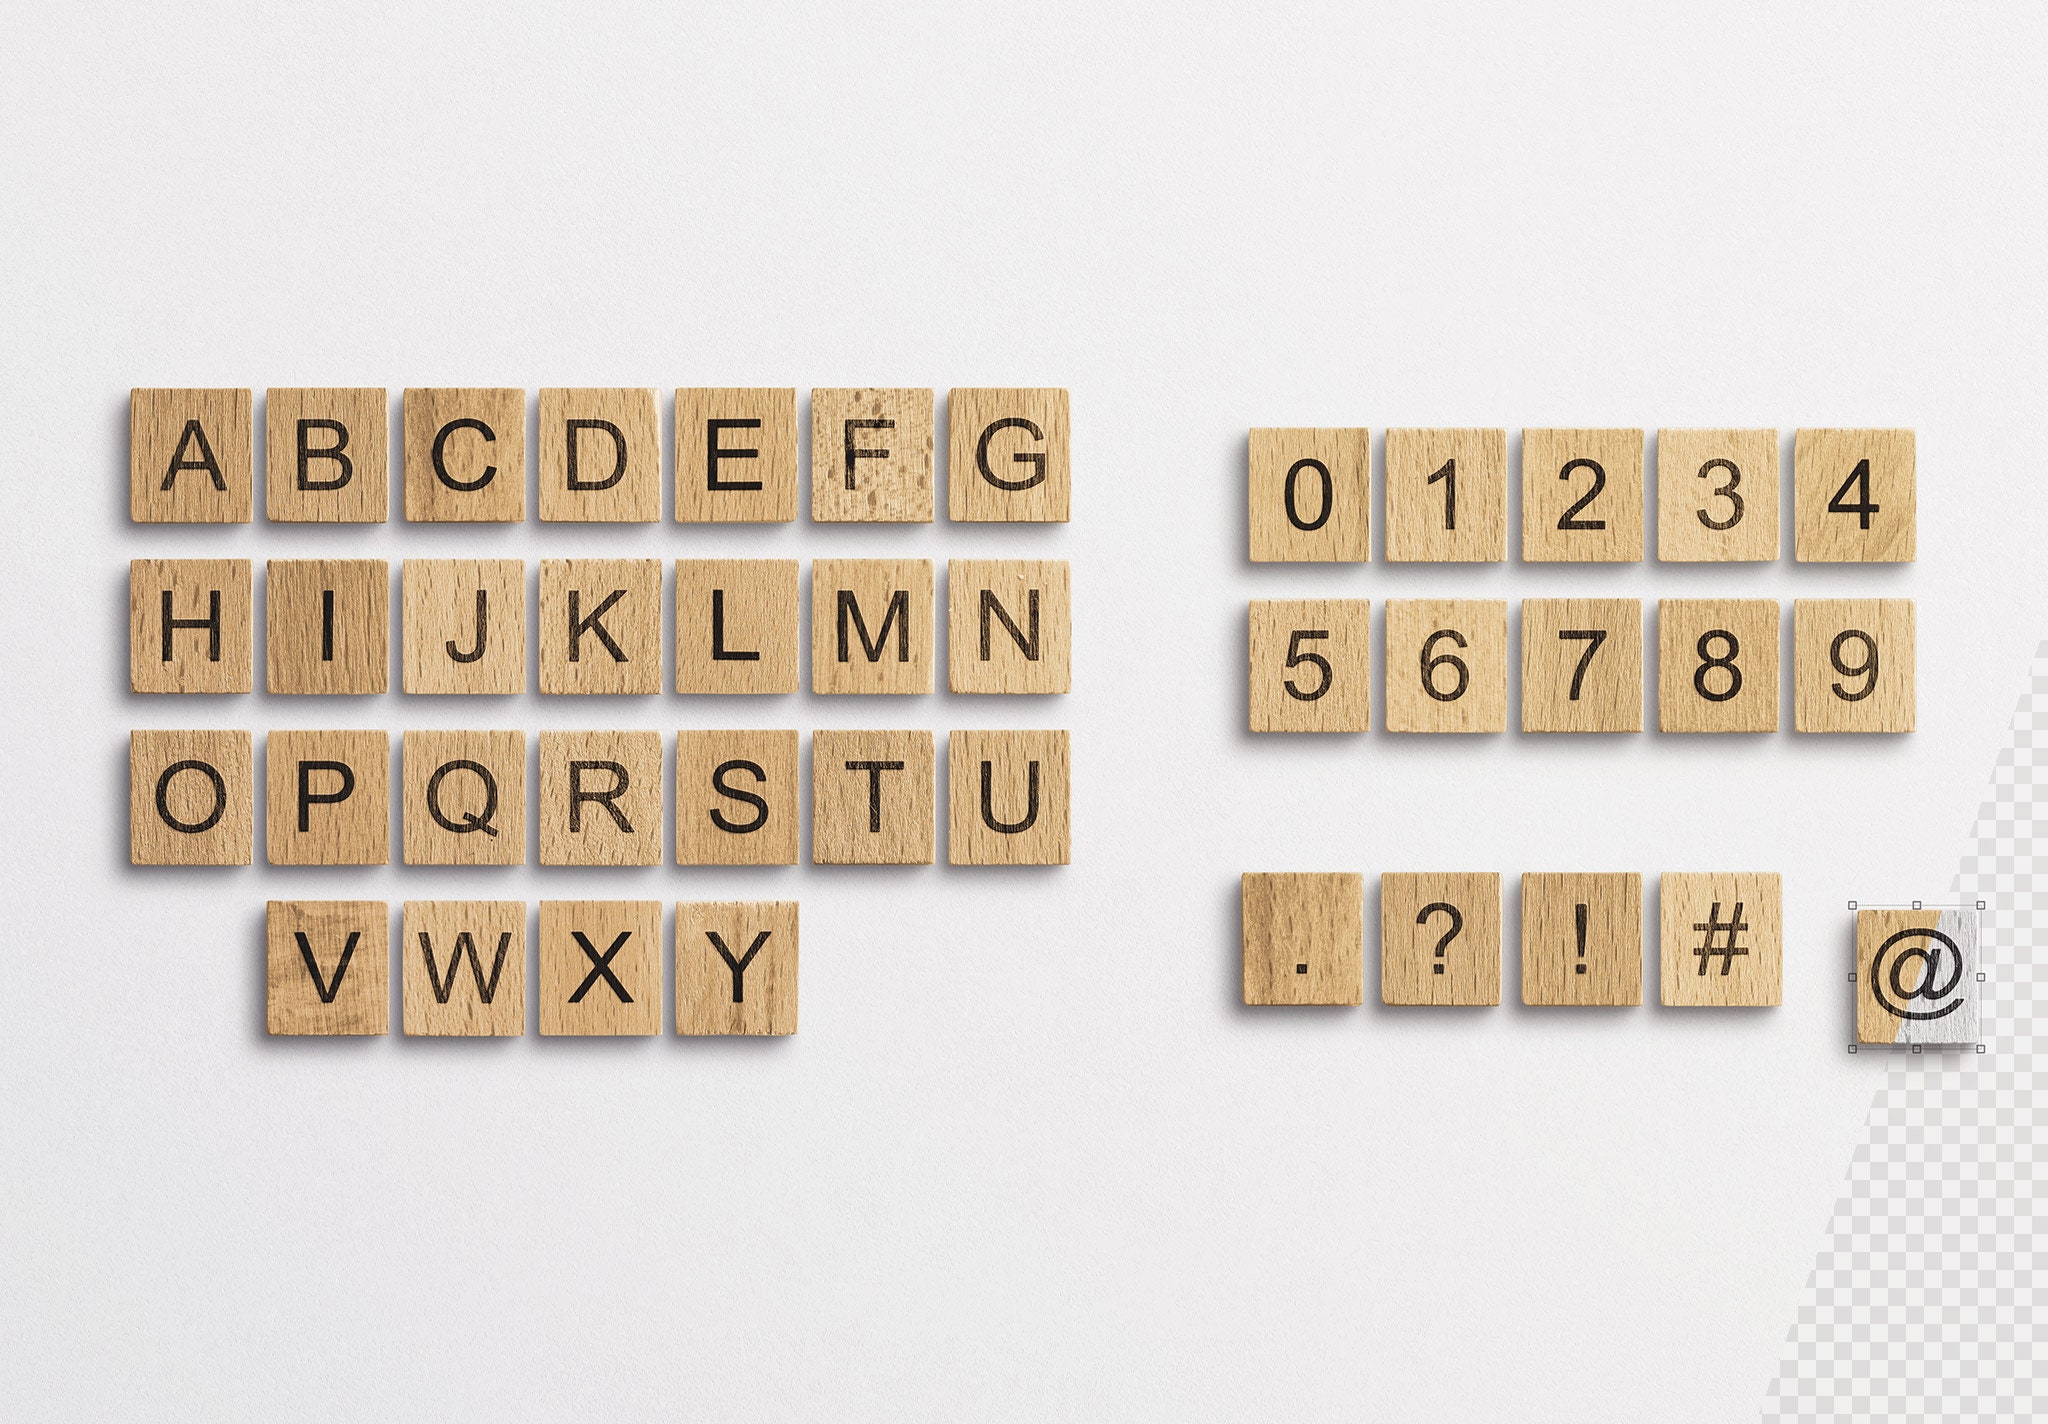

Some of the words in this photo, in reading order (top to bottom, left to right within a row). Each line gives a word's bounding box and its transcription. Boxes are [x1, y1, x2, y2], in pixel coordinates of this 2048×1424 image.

[160, 419, 227, 492] A
[296, 418, 353, 491] B
[430, 418, 497, 492] C
[566, 419, 627, 492] D
[707, 418, 763, 491] E
[844, 418, 895, 492] F
[976, 417, 1045, 492] G
[1284, 458, 1333, 531] 0
[1427, 459, 1456, 530] 1
[1557, 458, 1606, 530] 2
[1697, 459, 1743, 529] 3
[1828, 459, 1880, 530] 4
[161, 590, 221, 663] H
[321, 589, 334, 662] I
[446, 590, 487, 663] J
[568, 590, 628, 663] K
[712, 589, 760, 661] L
[836, 590, 909, 663] M
[980, 590, 1039, 661] N
[1284, 630, 1332, 702] 5
[1420, 630, 1469, 702] 6
[1559, 630, 1607, 701] 7
[1693, 629, 1742, 702] 8
[1830, 630, 1879, 702] 9
[155, 759, 227, 834] O
[298, 760, 355, 833] P
[426, 759, 498, 837] Q
[569, 760, 634, 833] R
[709, 759, 769, 834] S
[845, 761, 905, 833] T
[980, 760, 1039, 835] U
[294, 931, 361, 1004] V
[418, 932, 511, 1005] W
[568, 931, 634, 1004] X
[705, 931, 772, 1004] Y
[1416, 902, 1463, 975] ?
[1575, 904, 1587, 975] !
[1692, 902, 1749, 976] #
[1871, 928, 1964, 1021] @
